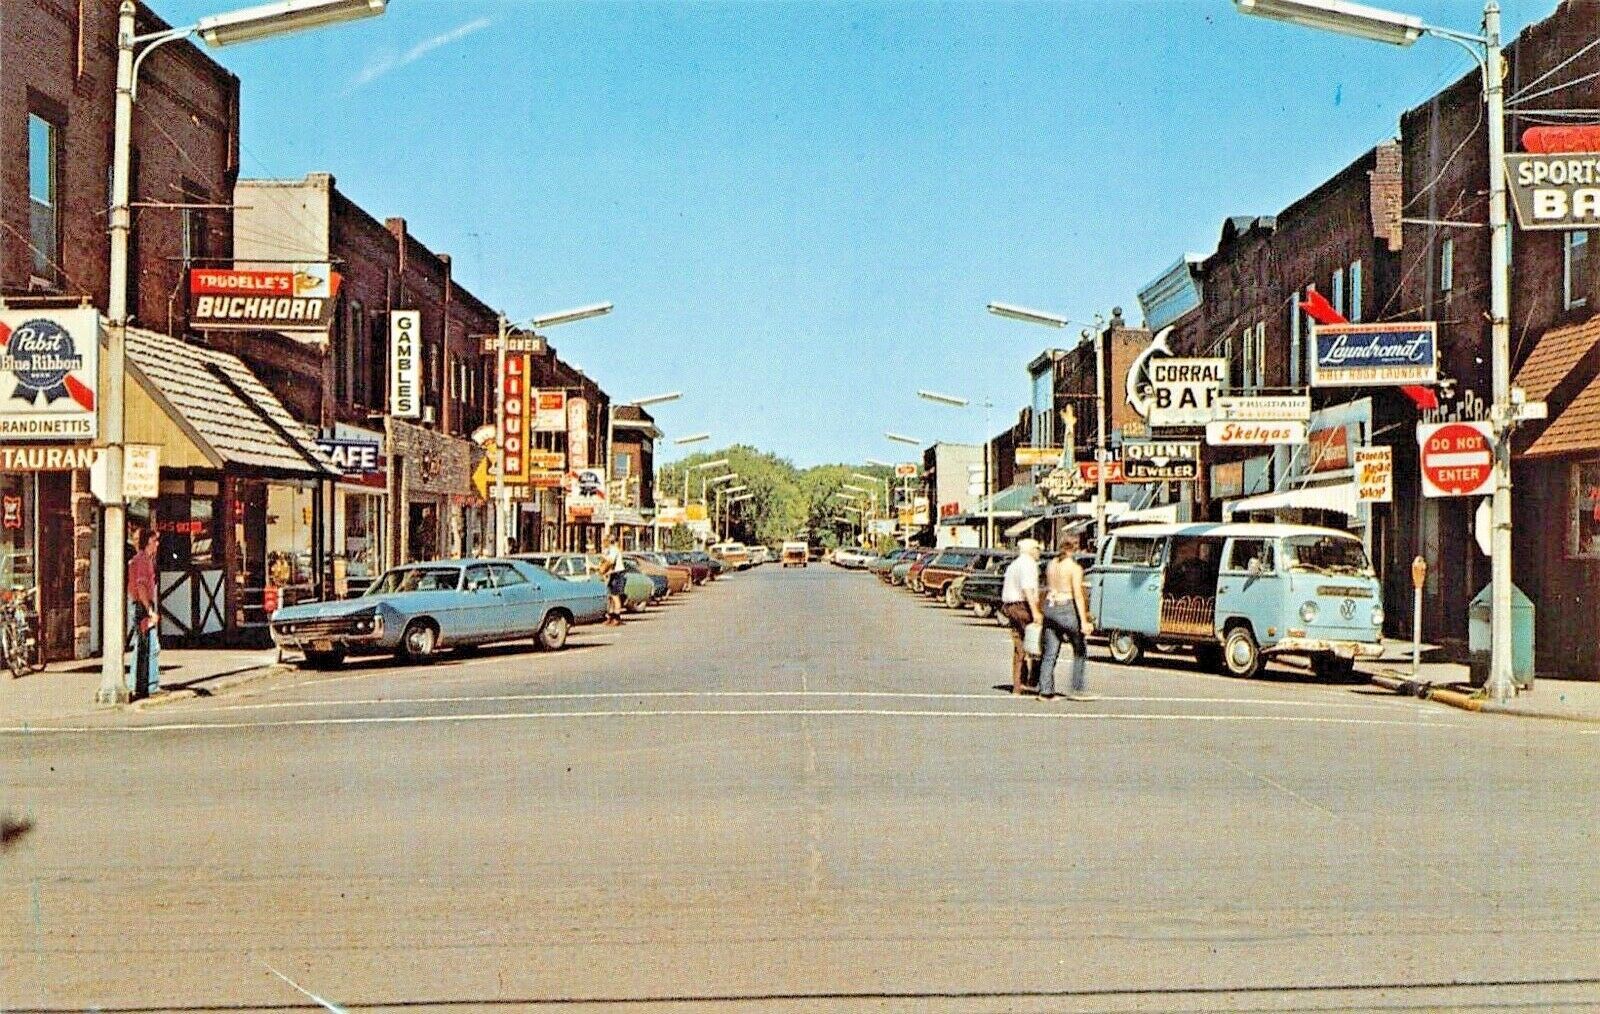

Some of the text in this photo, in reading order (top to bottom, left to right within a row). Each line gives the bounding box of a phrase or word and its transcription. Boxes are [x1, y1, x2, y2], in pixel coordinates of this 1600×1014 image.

[199, 274, 289, 290] TRUDELLE'S
[196, 296, 322, 320] BUCHHORN
[17, 328, 63, 351] Pabst
[484, 338, 540, 351] SPONER
[1319, 334, 1430, 363] Laundromat
[2, 354, 82, 371] Blue Ribbon
[397, 317, 411, 411] GAMBLES
[1155, 365, 1224, 382] CORRAL
[505, 359, 522, 472] LIQUOR
[1221, 423, 1291, 444] Skelgas
[1128, 444, 1192, 458] QUINN
[1431, 437, 1483, 450] DO NOT
[1128, 464, 1194, 478] JEWELER
[1438, 469, 1480, 482] ENTER
[489, 485, 530, 498] SORE
